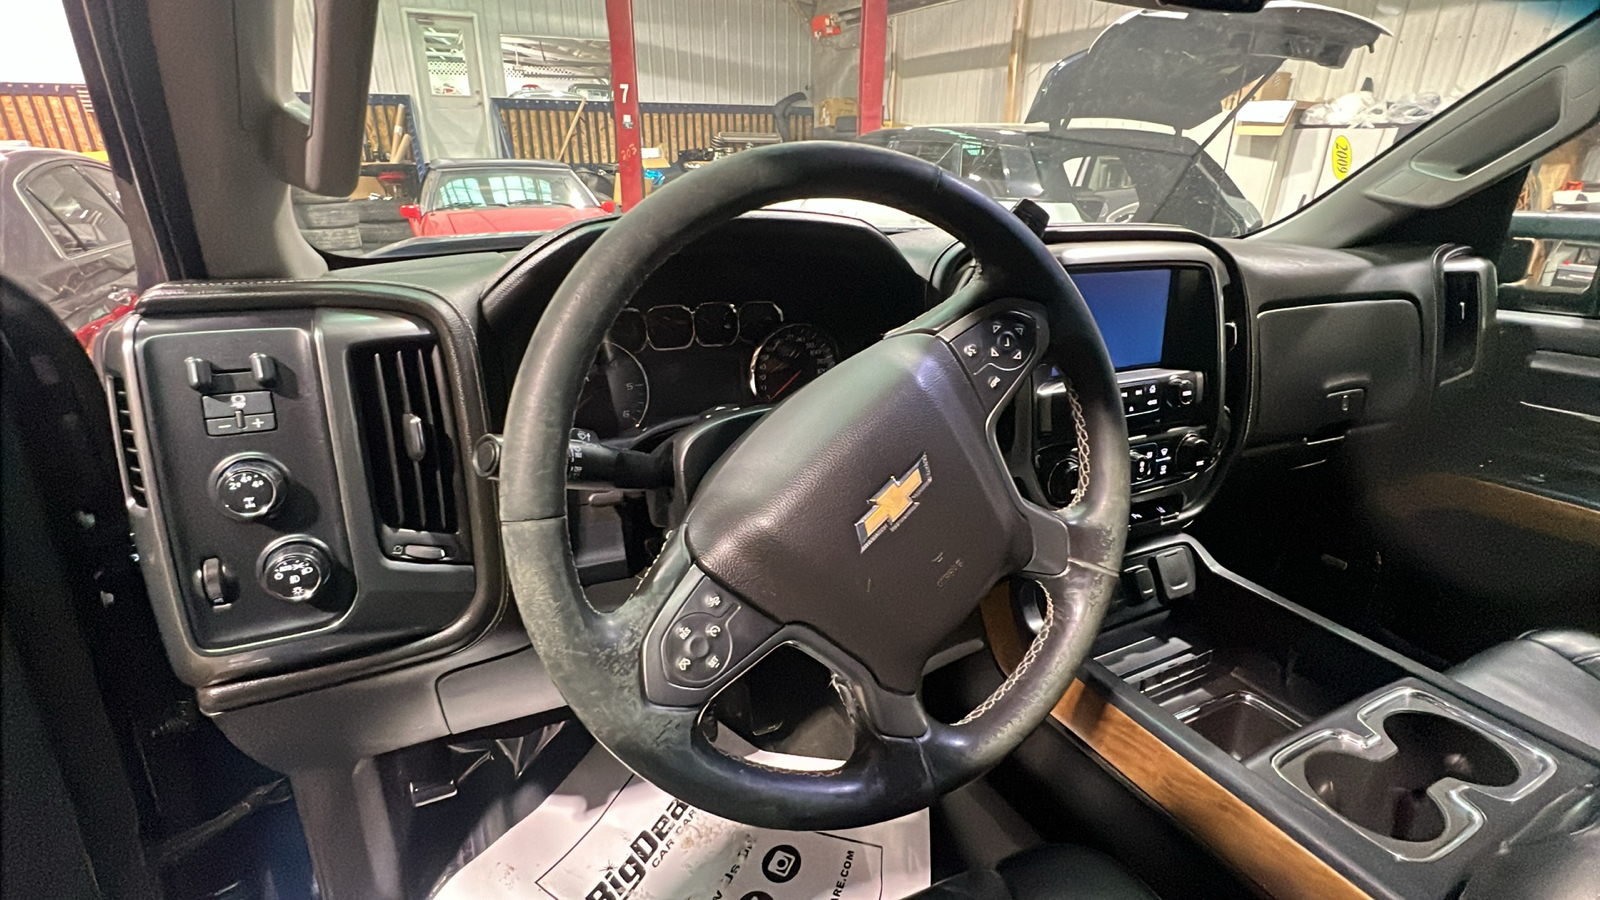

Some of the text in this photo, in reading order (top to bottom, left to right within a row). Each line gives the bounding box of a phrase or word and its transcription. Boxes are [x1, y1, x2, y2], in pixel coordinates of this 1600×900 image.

[619, 83, 629, 104] 7
[1336, 142, 1348, 173] 2009
[651, 809, 697, 868] CAR CAR
